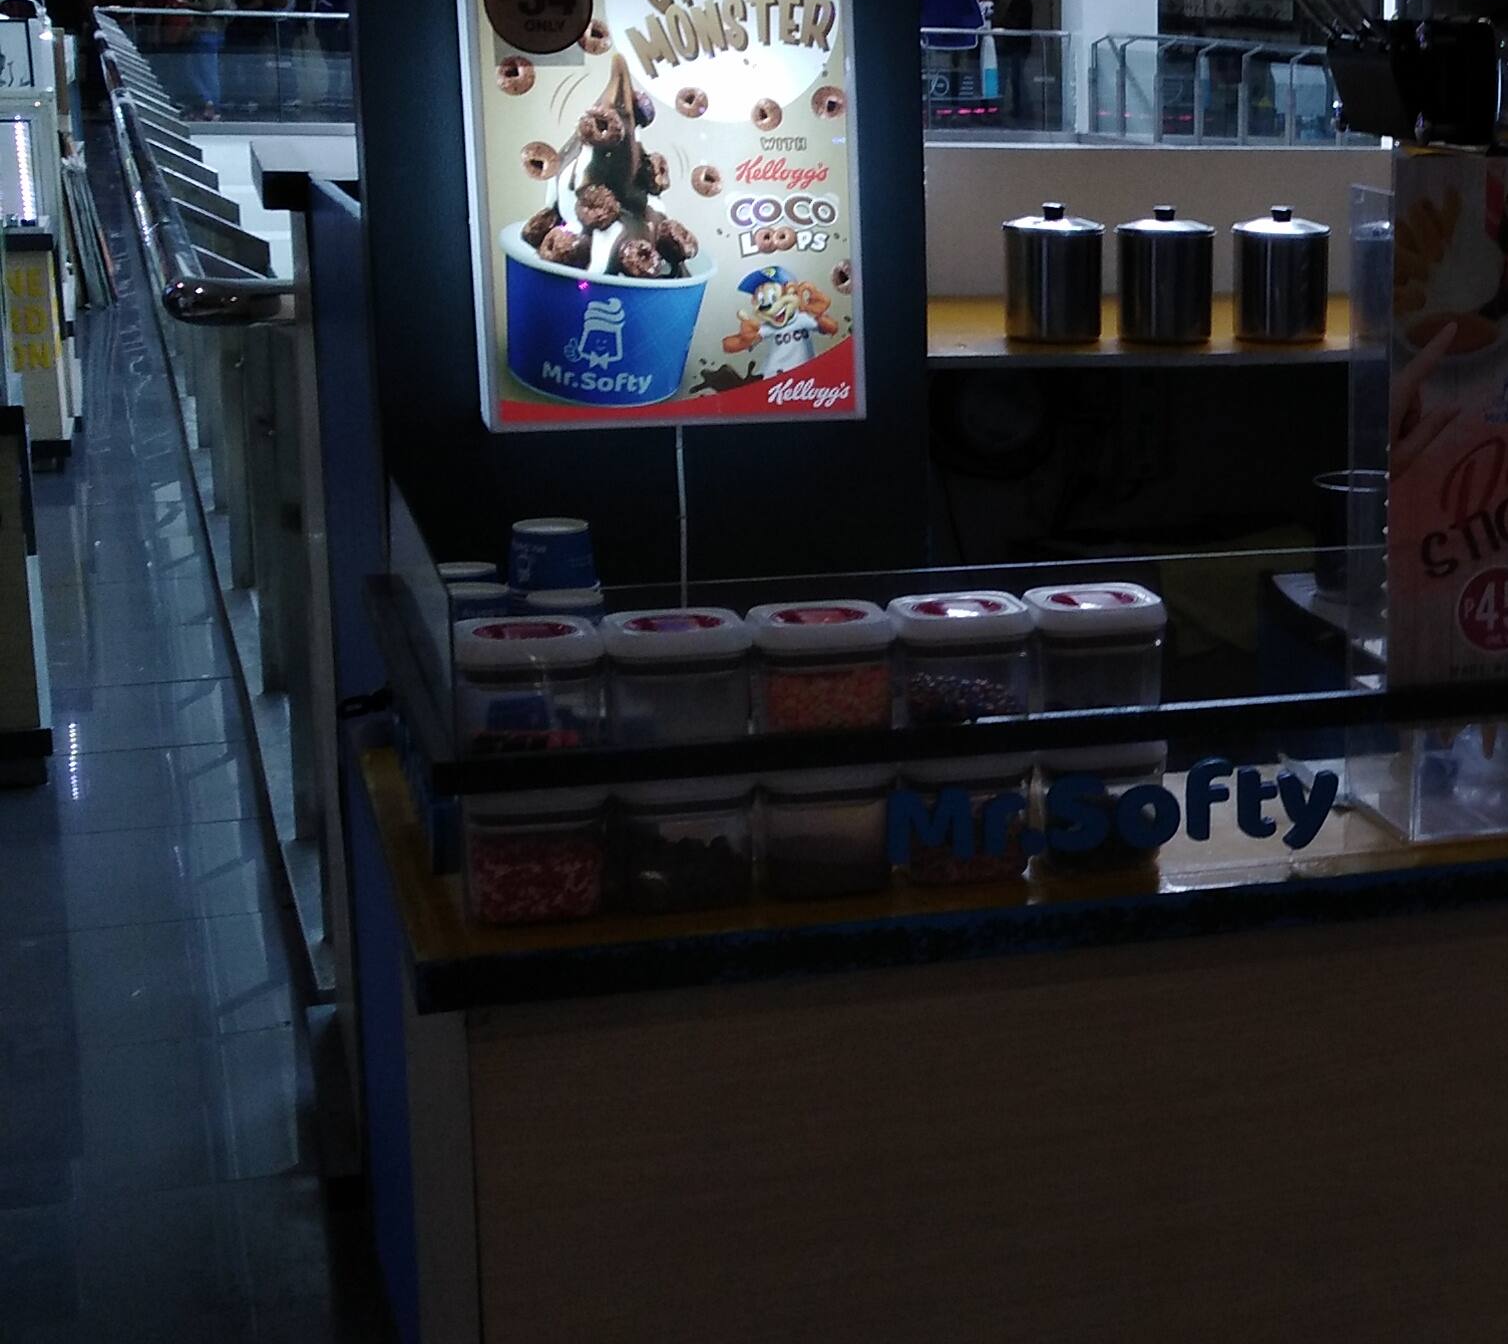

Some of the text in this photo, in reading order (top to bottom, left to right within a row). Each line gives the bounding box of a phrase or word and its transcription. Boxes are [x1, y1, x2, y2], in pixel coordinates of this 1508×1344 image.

[760, 137, 807, 151] WITH
[735, 156, 829, 190] Kellogg's
[730, 196, 836, 227] COCO
[739, 226, 830, 258] LOOPS
[774, 328, 810, 348] COCO
[541, 360, 653, 396] Mr.Softy
[767, 378, 851, 408] Kellogg's
[888, 756, 1339, 864] Mr.Softy
